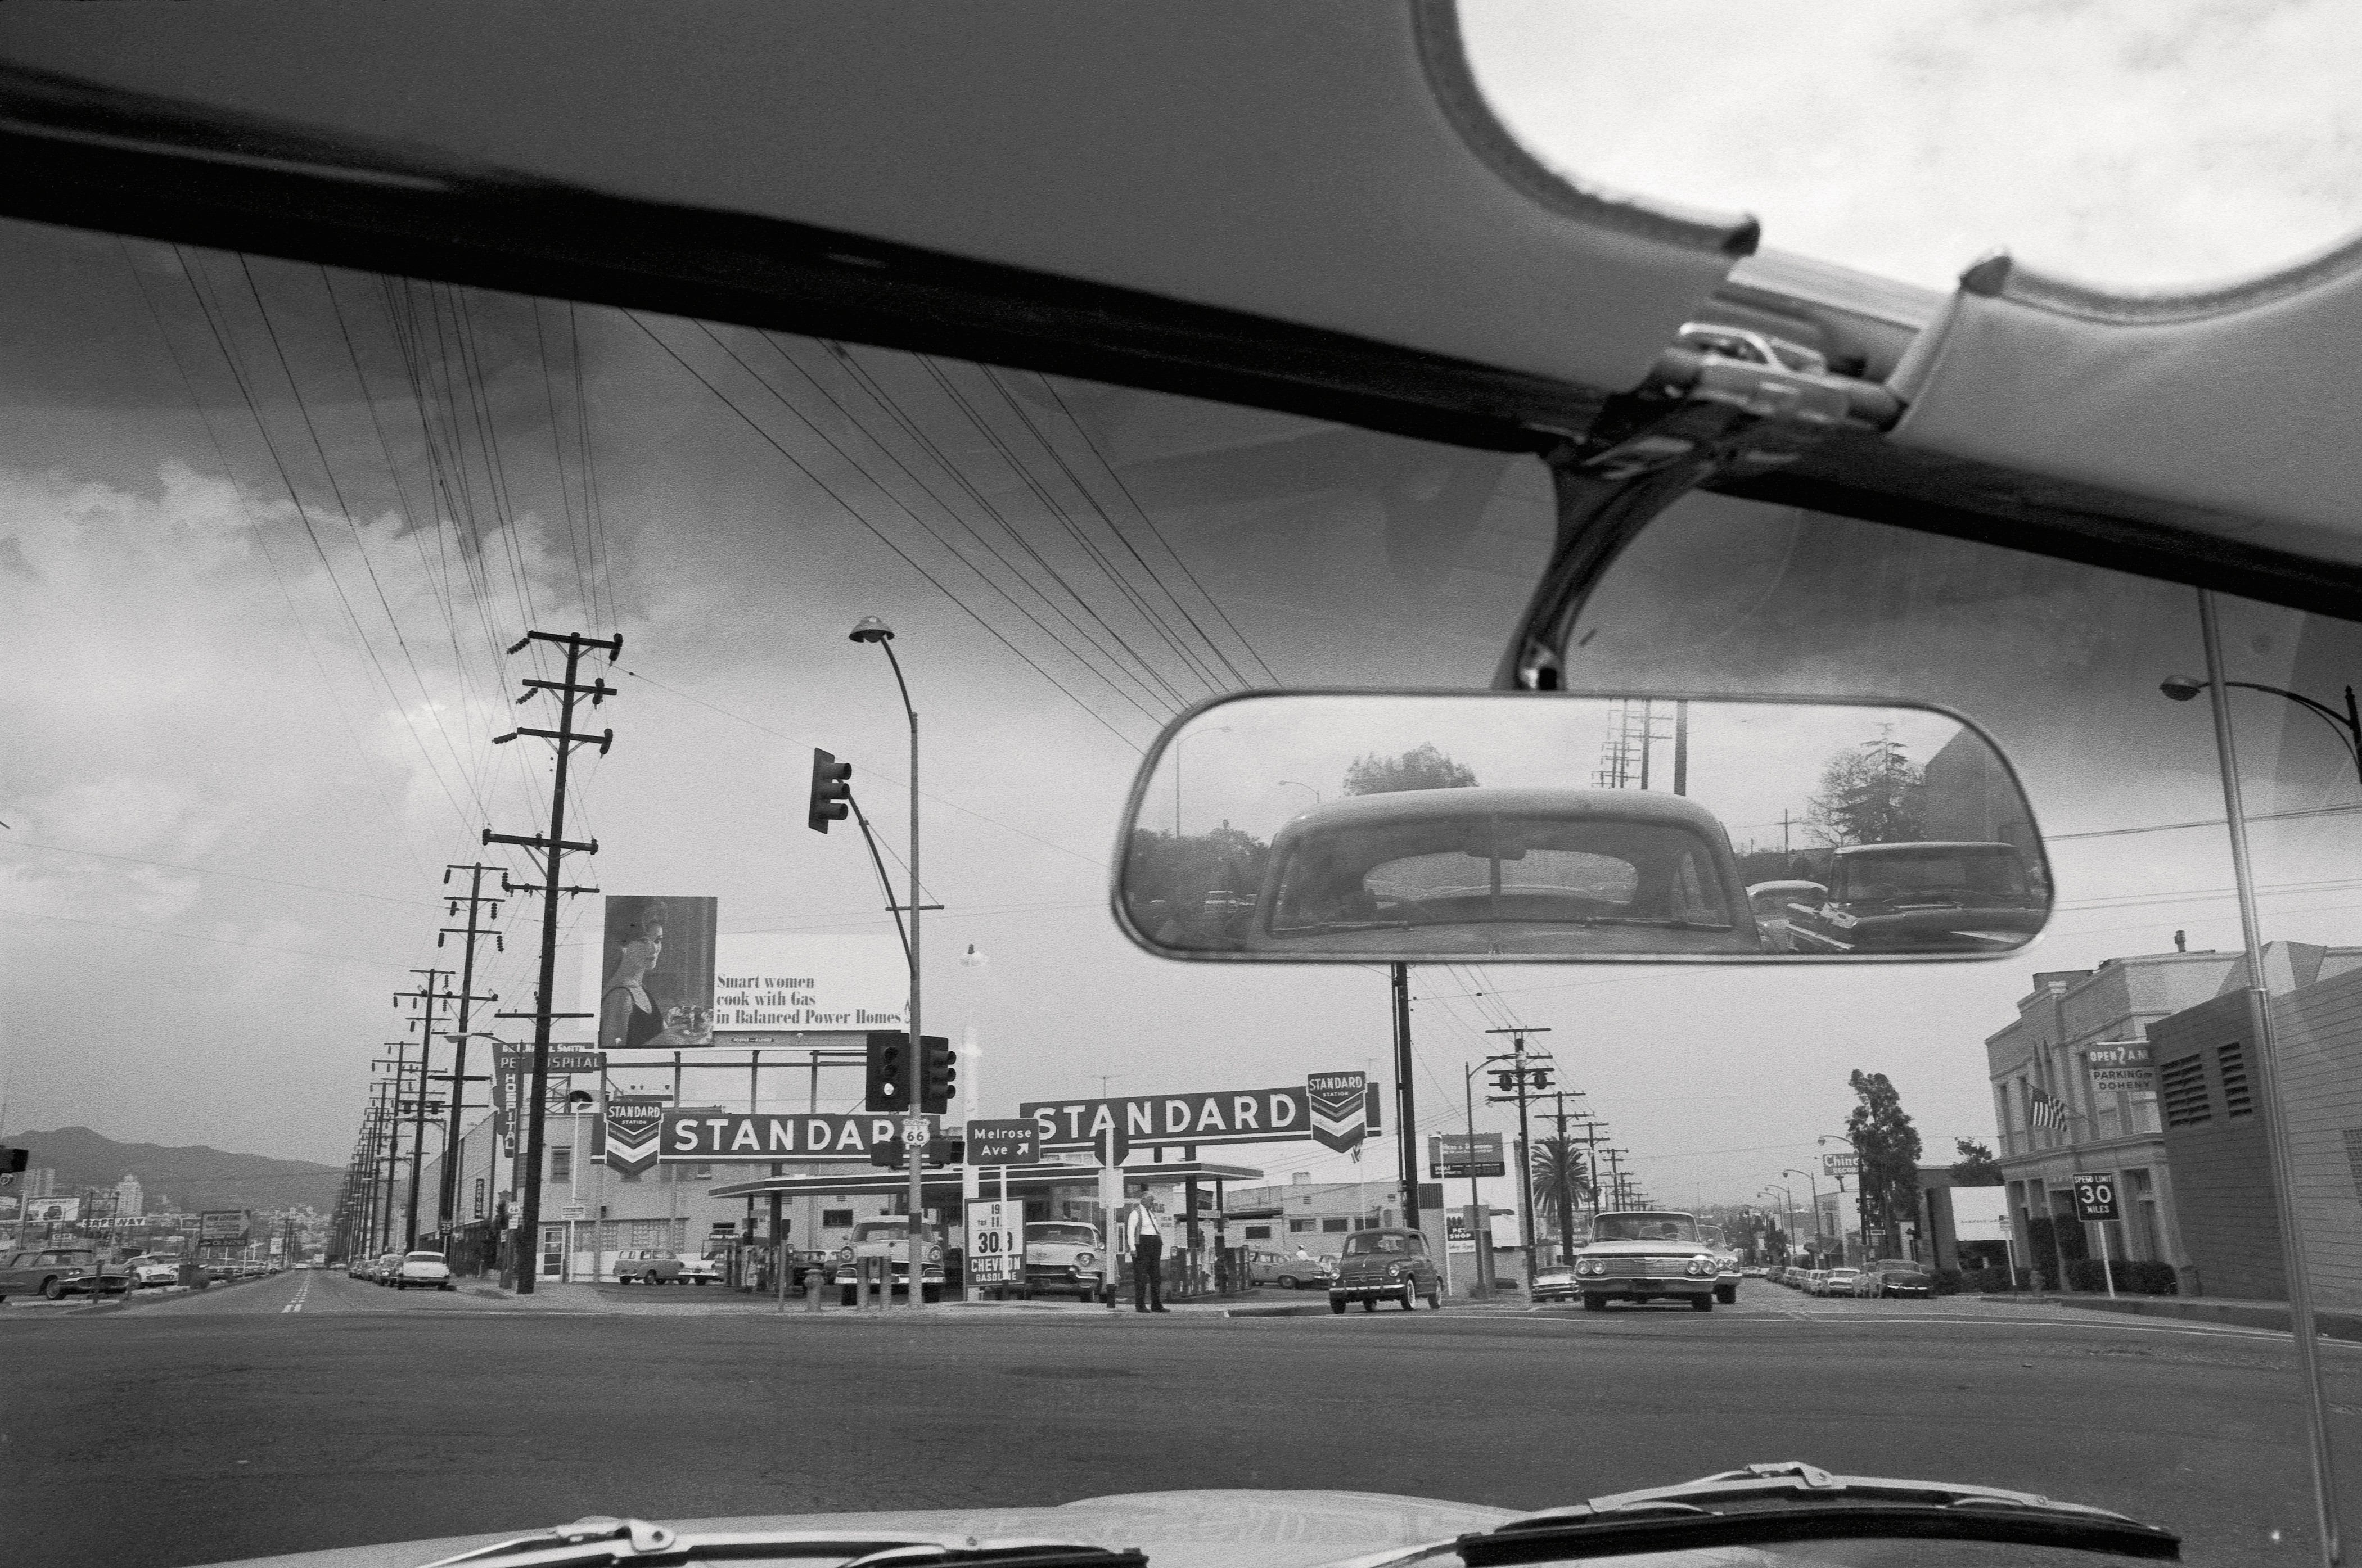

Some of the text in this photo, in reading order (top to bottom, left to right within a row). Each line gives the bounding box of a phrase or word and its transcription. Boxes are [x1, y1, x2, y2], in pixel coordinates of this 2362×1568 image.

[717, 975, 815, 988] Smart women
[716, 991, 815, 1006] cook with Gas
[716, 1009, 729, 1024] in
[735, 1009, 800, 1024] Balanced
[806, 1009, 851, 1024] Power
[856, 1009, 901, 1024] Homes
[2090, 1050, 2117, 1062] OPEN
[2117, 1047, 2126, 1065] 2
[2093, 1069, 2143, 1079] PARKING
[1309, 1076, 1363, 1091] STANDARD
[2099, 1081, 2150, 1090] DOHENY
[506, 1072, 517, 1150] HOSPITAL
[608, 1106, 660, 1118] STANDARD
[1035, 1093, 1297, 1140] STANDARD
[907, 1131, 924, 1142] 66
[975, 1128, 1031, 1140] Melrose
[981, 1145, 1008, 1156] Ave
[2080, 1185, 2112, 1204] 30
